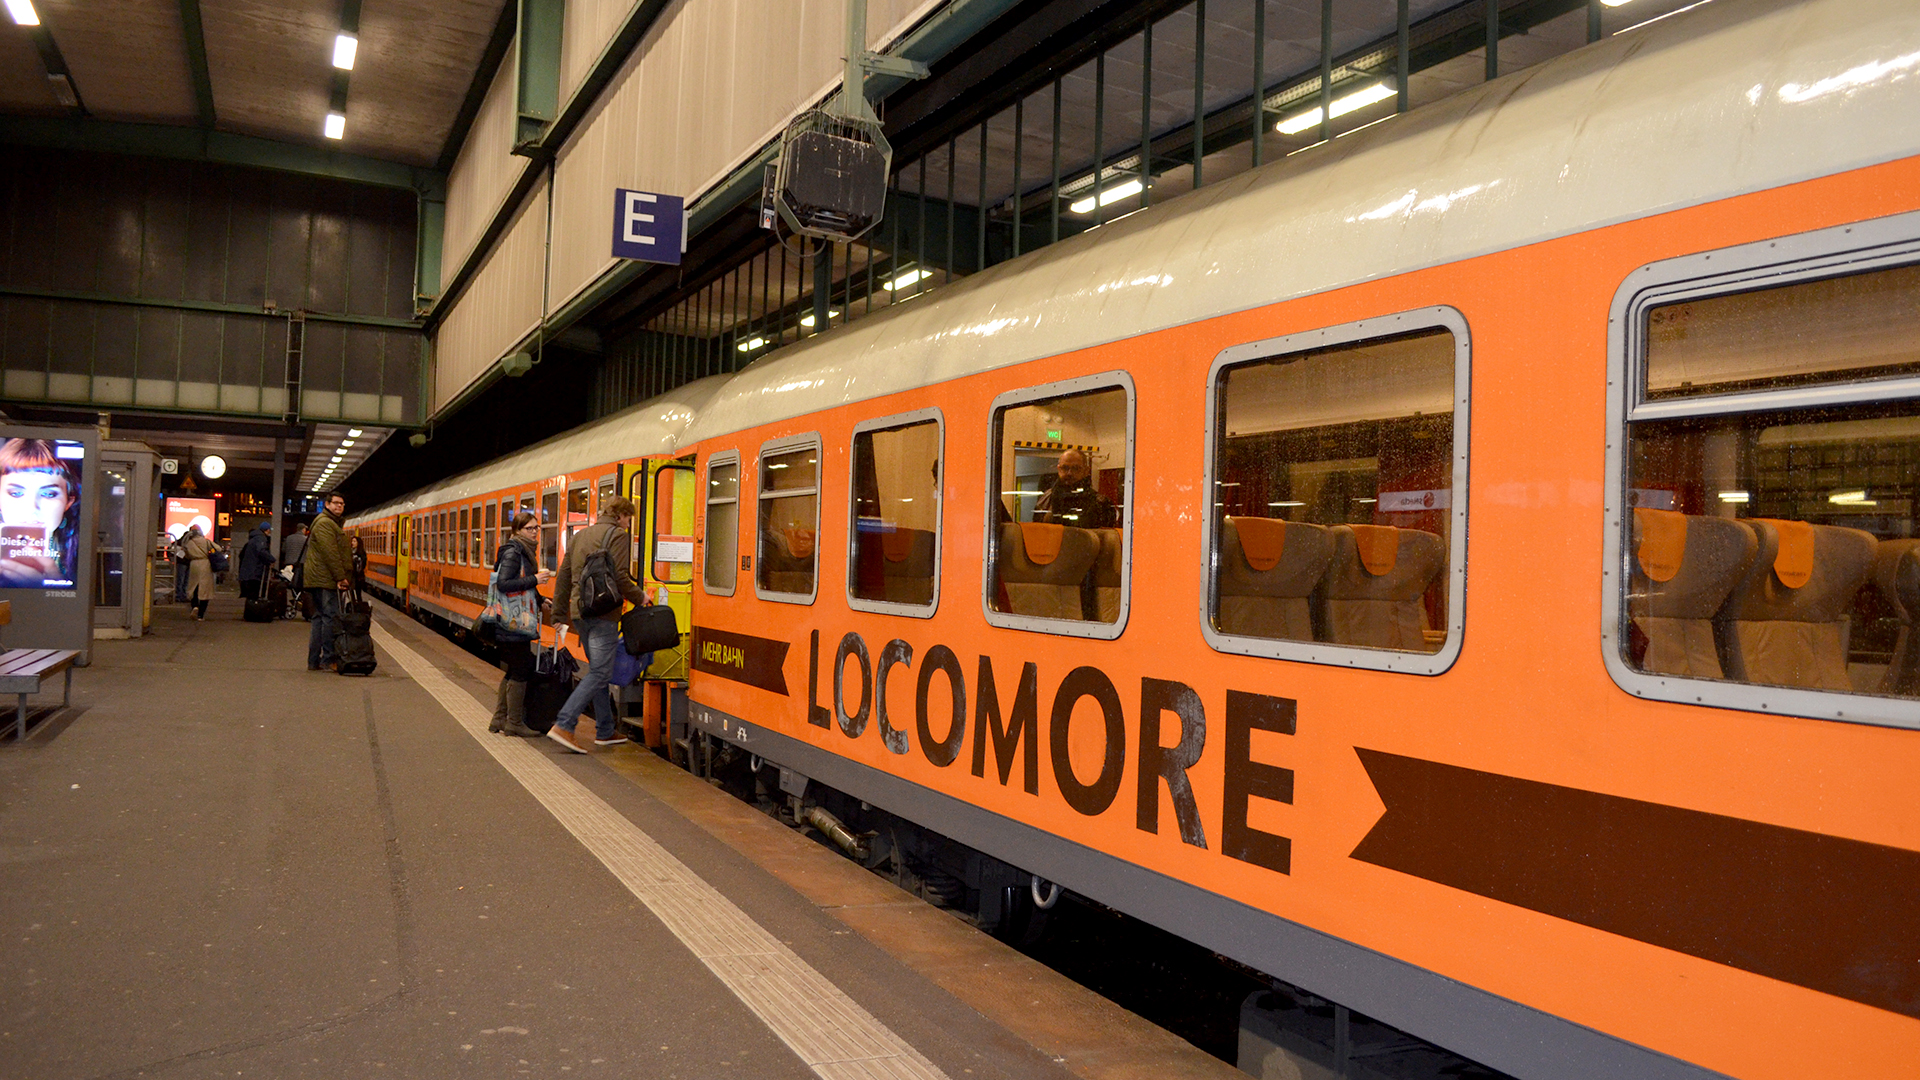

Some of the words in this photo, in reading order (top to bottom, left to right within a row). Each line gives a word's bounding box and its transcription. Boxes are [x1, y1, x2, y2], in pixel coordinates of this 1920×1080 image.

[623, 191, 657, 245] E
[1, 537, 27, 547] Diese
[10, 548, 42, 558] gehört
[43, 549, 60, 558] Dir.
[702, 640, 722, 664] MEHR
[723, 644, 745, 669] BAHN
[807, 629, 1298, 876] LOCOMORE
